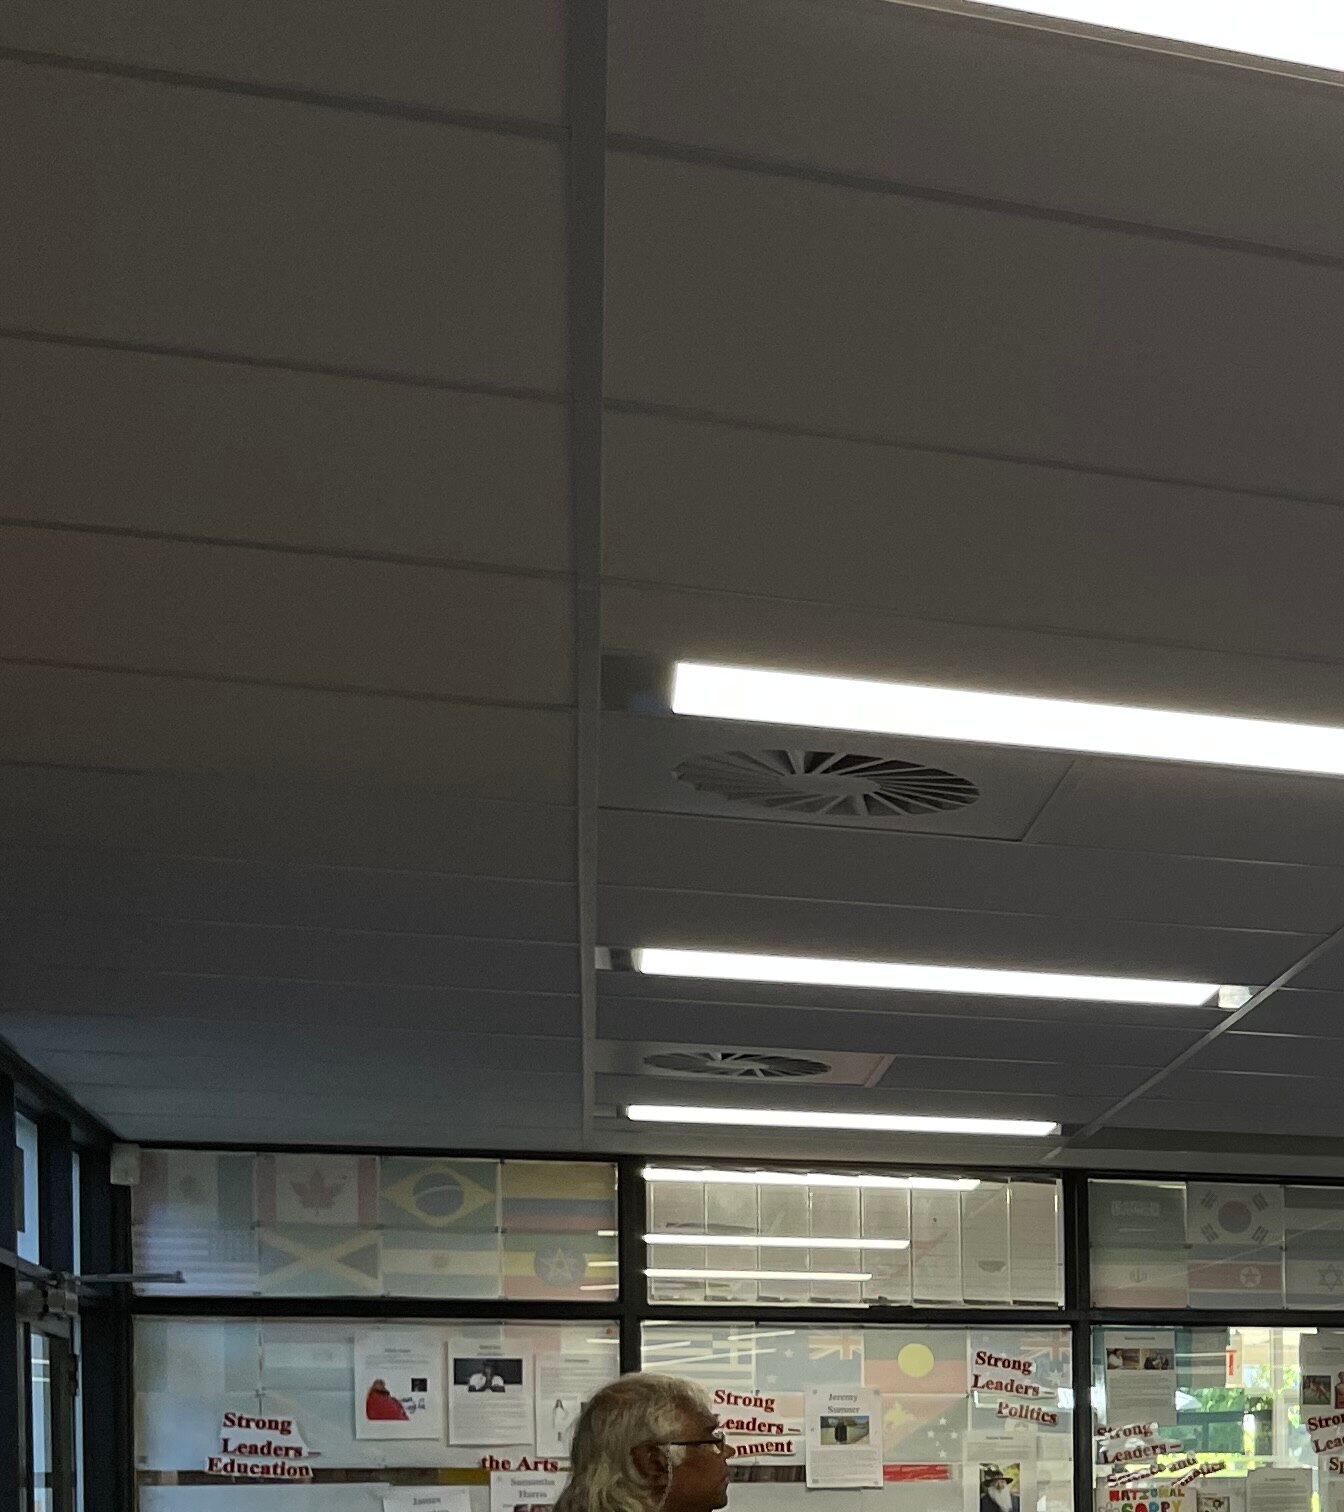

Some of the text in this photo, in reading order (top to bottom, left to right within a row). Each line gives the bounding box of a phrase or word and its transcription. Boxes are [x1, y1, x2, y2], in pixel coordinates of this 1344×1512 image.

[975, 1351, 1033, 1376] Strong
[971, 1373, 1040, 1397] Leaders
[714, 1389, 776, 1413] Strong
[997, 1401, 1057, 1424] Politics
[222, 1411, 293, 1436] Strong
[221, 1438, 303, 1457] Leaders
[1102, 1443, 1167, 1464] Leaders
[207, 1456, 310, 1477] Education
[481, 1455, 560, 1472] the Arts
